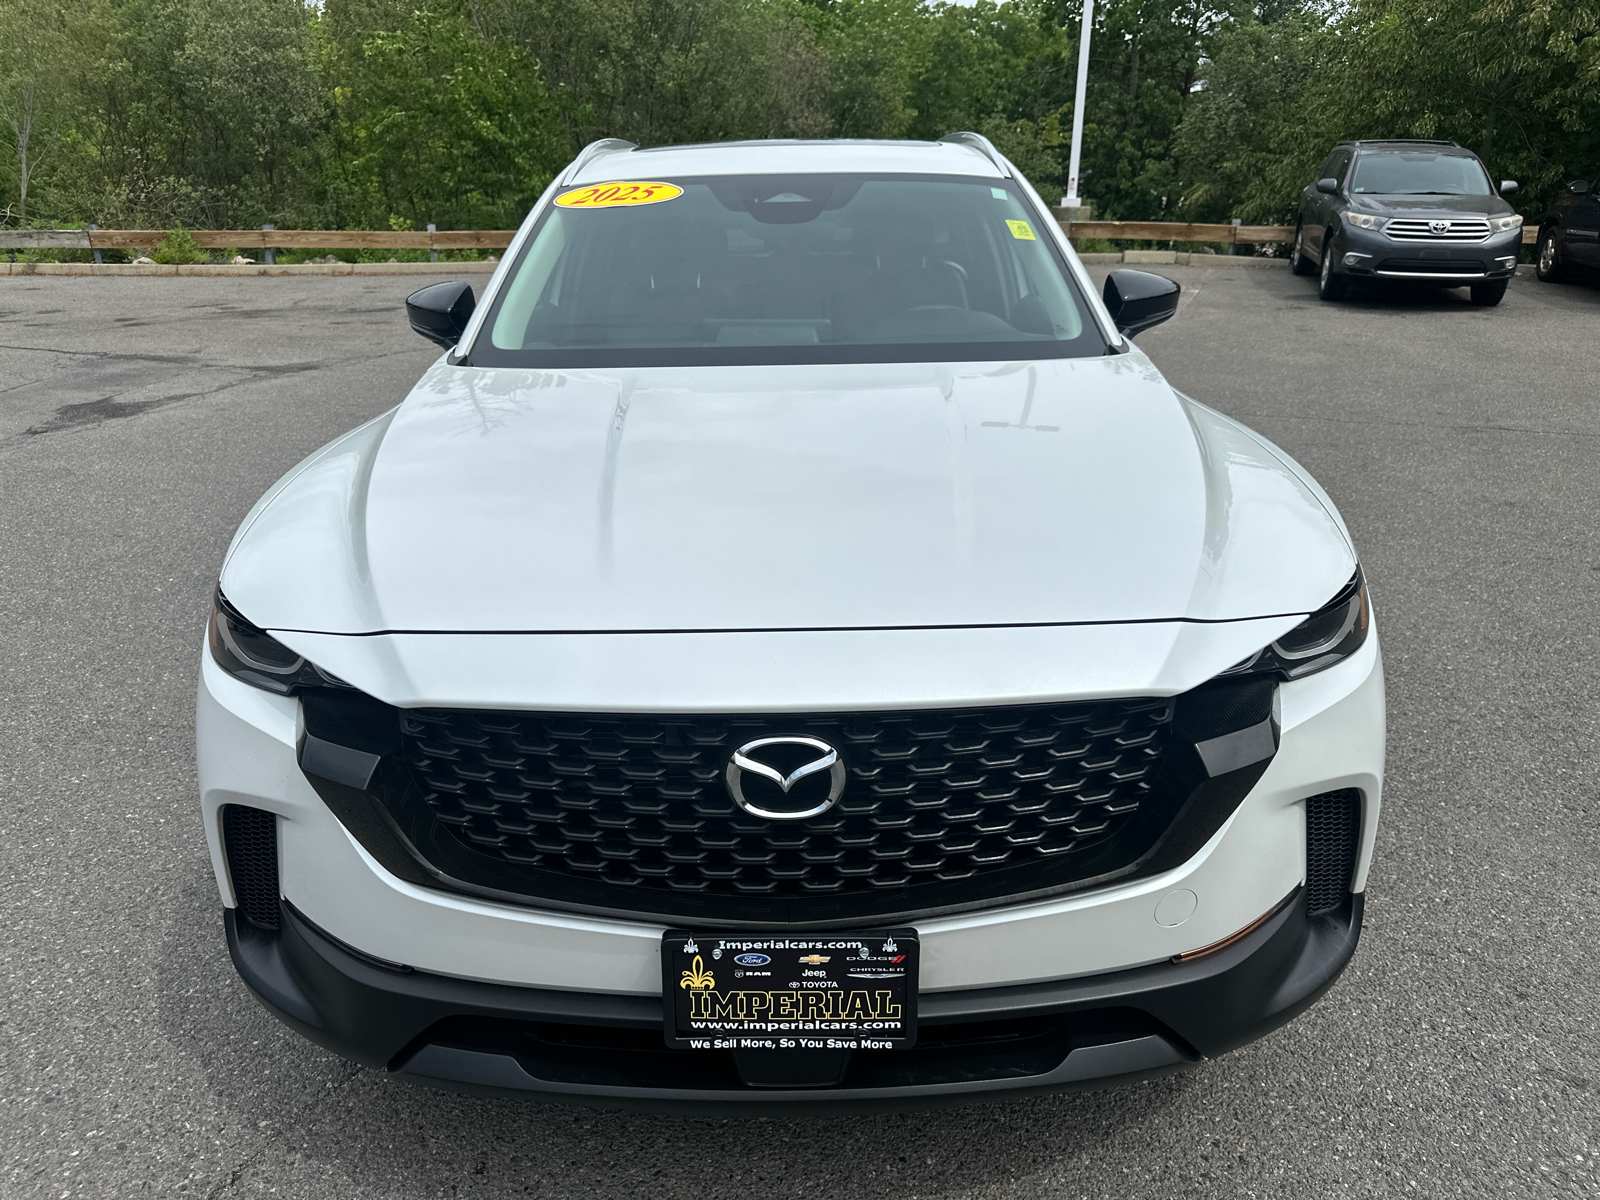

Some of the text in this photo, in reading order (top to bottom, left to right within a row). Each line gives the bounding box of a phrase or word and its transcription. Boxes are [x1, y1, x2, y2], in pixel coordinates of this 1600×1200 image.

[569, 185, 664, 205] 2025
[718, 939, 862, 951] Imperialcars.com
[742, 955, 763, 964] Ford
[801, 968, 827, 978] Jeep
[689, 990, 902, 1020] IMPERIAL
[690, 1020, 902, 1032] www.imperialcars.com
[689, 1038, 893, 1050] We Sell More, So You Save More
